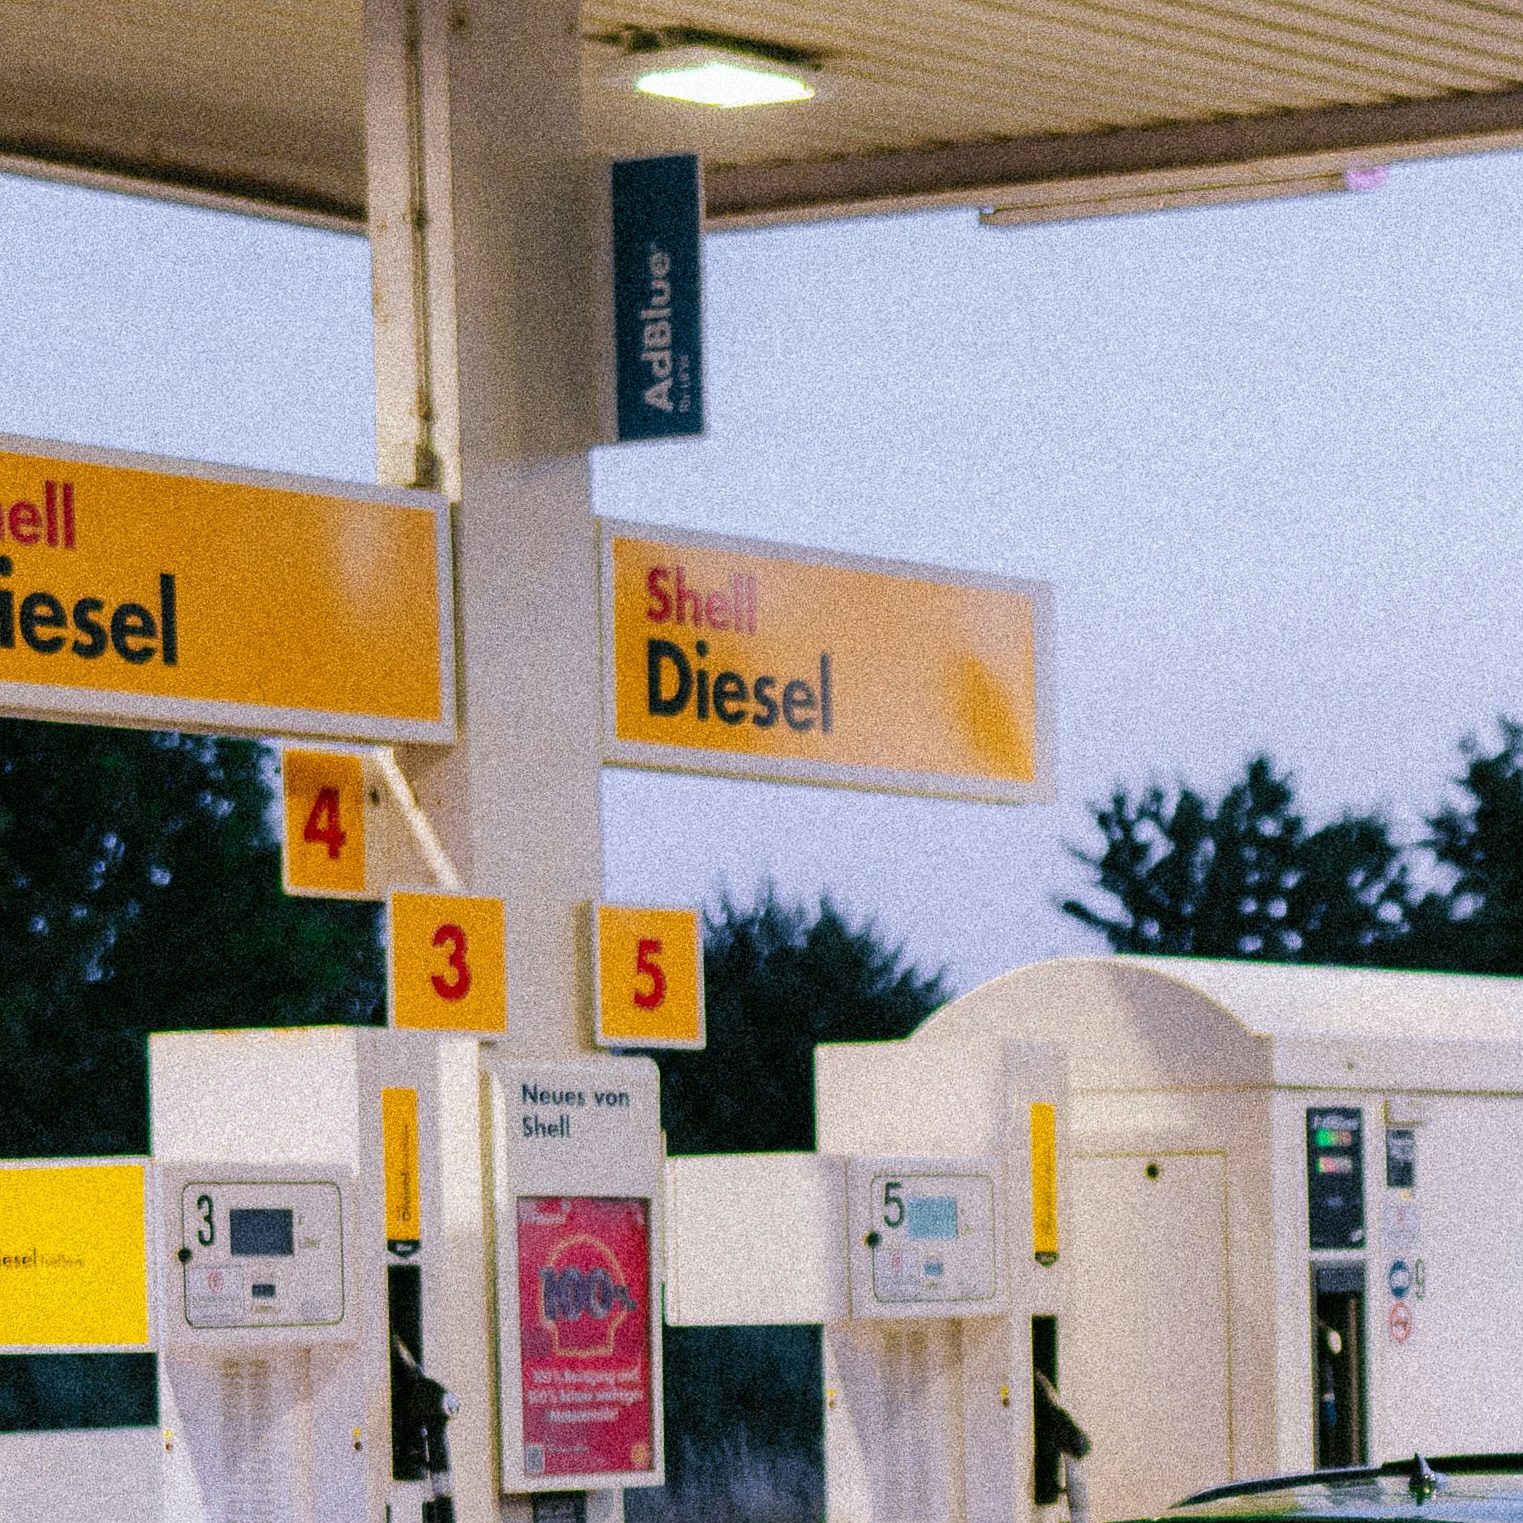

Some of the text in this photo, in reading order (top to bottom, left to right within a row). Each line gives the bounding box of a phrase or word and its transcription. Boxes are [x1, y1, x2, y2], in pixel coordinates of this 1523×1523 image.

[643, 249, 676, 413] AdBlue
[0, 480, 76, 549] ell
[0, 554, 178, 667] iesel
[647, 564, 757, 634] Shell
[647, 638, 833, 735] Diesel
[303, 785, 347, 860] 4
[430, 924, 472, 1001] 3
[634, 937, 667, 1012] 5
[521, 1083, 631, 1108] Neues von
[522, 1113, 570, 1138] Shell
[196, 1194, 215, 1247] 3
[883, 1181, 905, 1229] 5
